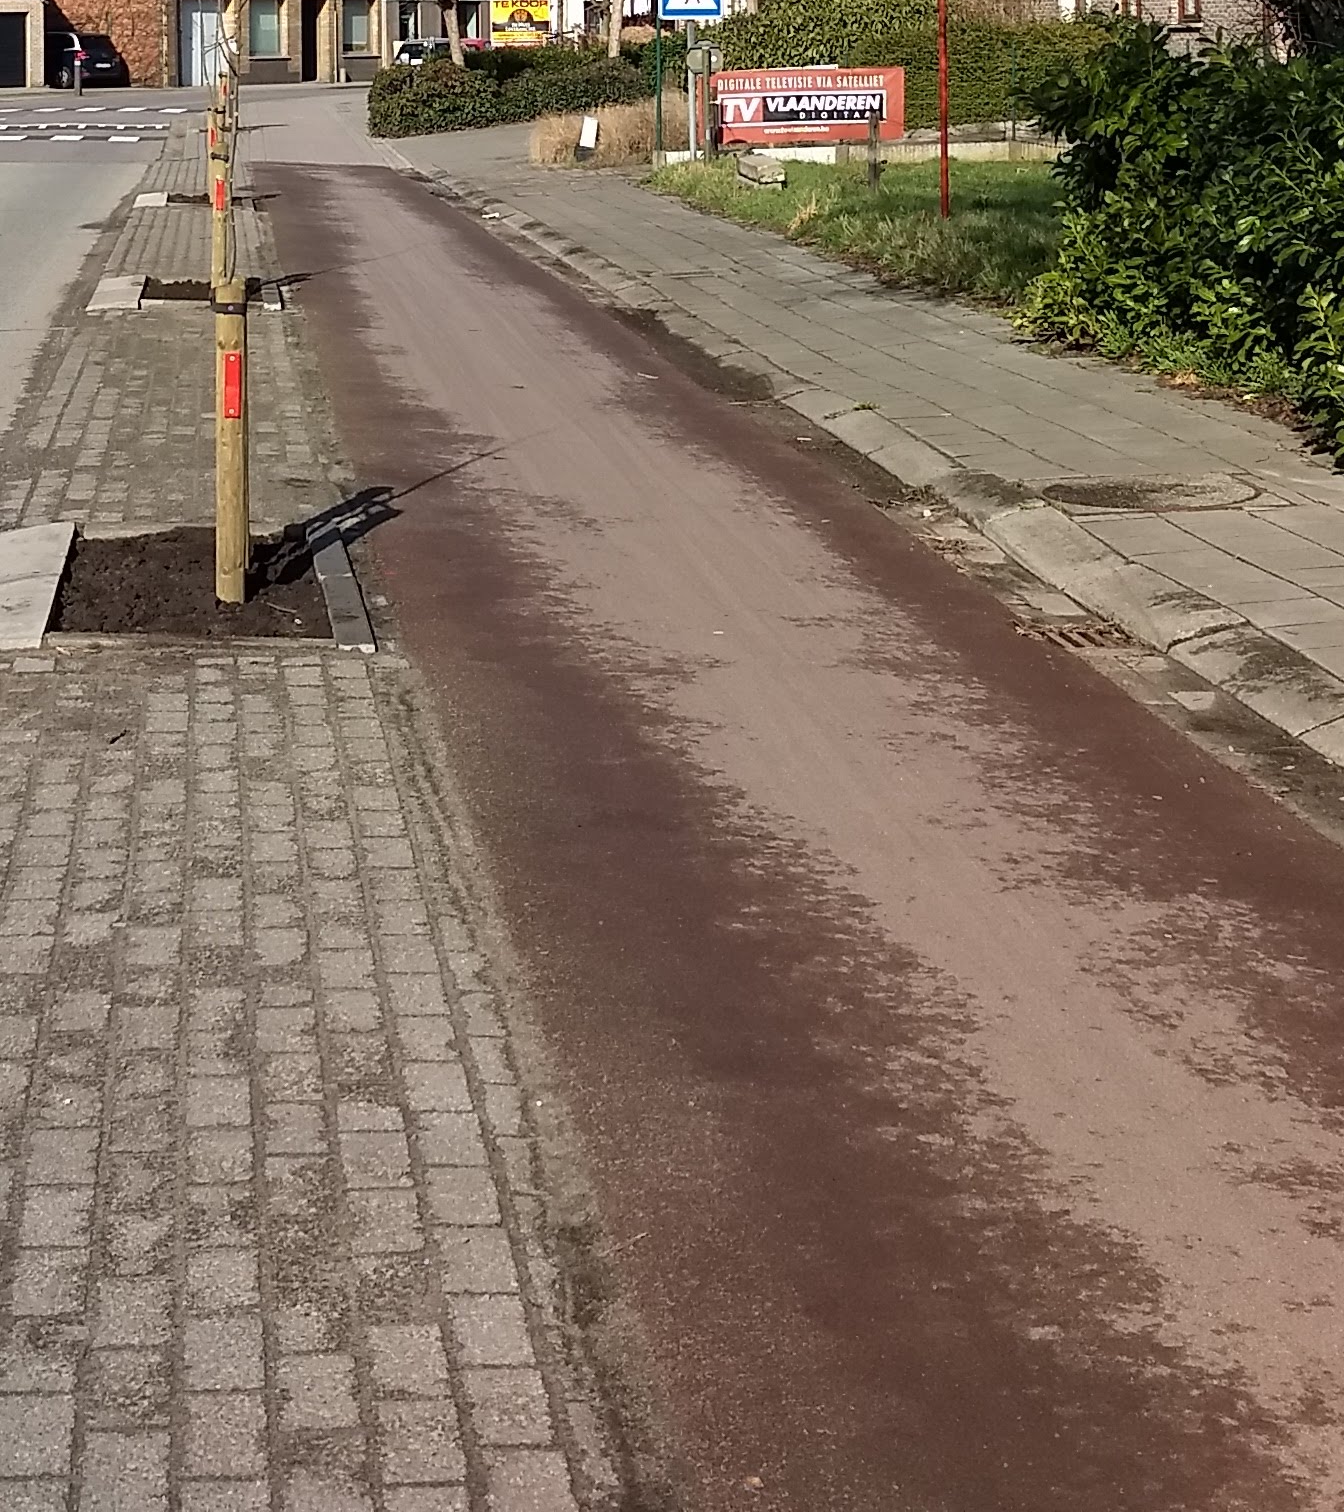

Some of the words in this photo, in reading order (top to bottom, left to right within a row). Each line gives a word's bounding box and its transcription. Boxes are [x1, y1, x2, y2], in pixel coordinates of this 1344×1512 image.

[493, 0, 509, 8] TE
[511, 0, 548, 8] KOOP
[717, 77, 761, 91] DIGITALE
[765, 76, 813, 90] TELEVISIE
[816, 76, 833, 88] VIA
[836, 75, 885, 88] SATELLIET
[722, 97, 761, 122] TV
[766, 95, 881, 112] VLAANDEREN
[799, 111, 875, 120] DIGITAA
